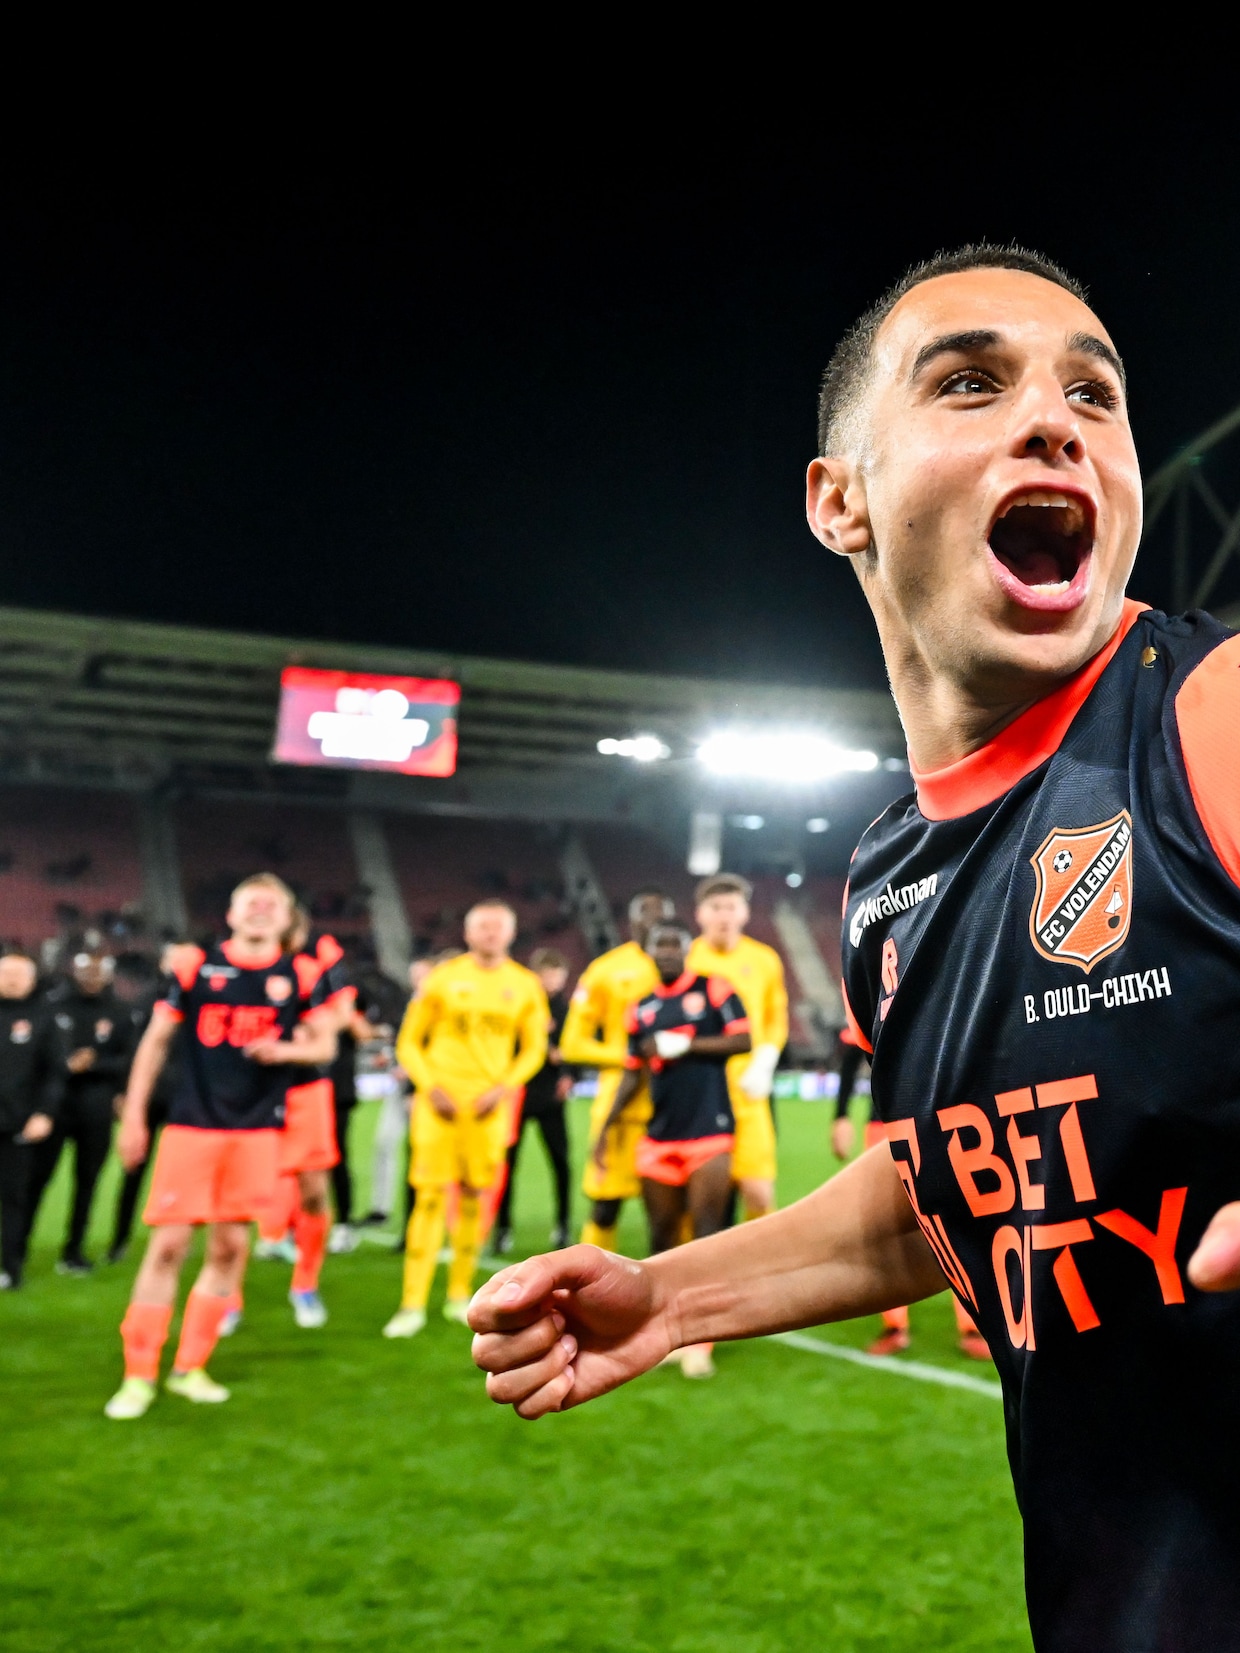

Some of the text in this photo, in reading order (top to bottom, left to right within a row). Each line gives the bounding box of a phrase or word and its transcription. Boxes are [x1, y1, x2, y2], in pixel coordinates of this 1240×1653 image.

[1040, 822, 1131, 949] FC VOLENDAM
[1024, 966, 1172, 1024] B. OULD-CHIKH
[936, 1073, 1099, 1218] BET
